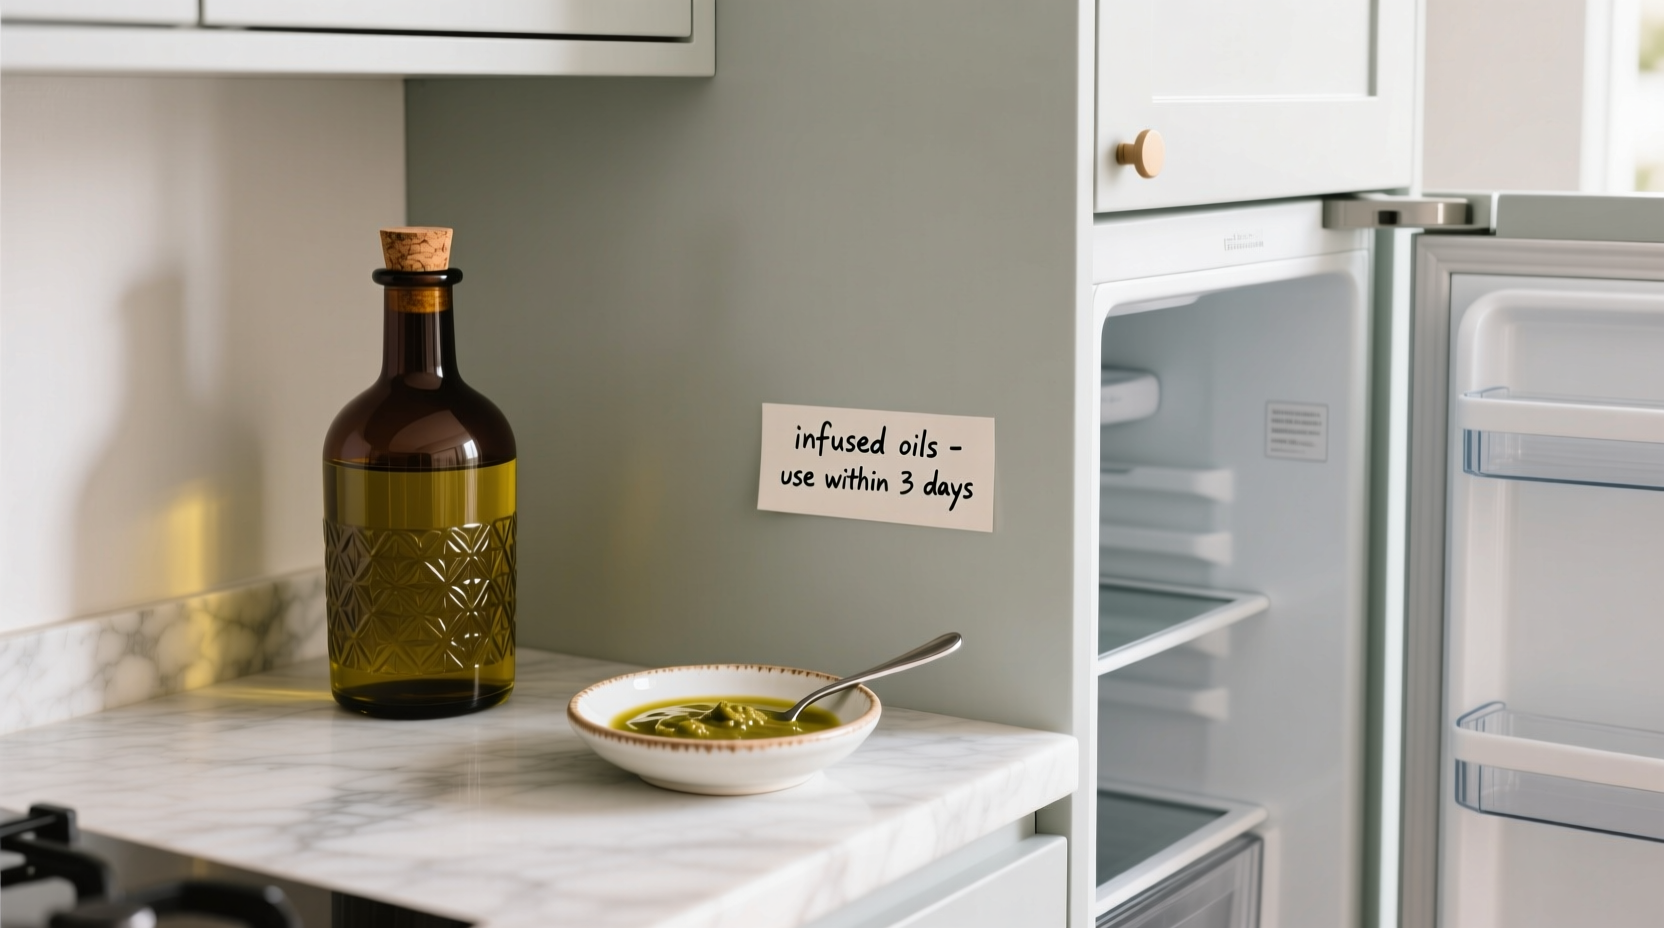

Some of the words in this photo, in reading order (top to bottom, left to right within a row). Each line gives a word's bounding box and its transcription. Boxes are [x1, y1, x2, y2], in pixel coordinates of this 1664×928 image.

[795, 420, 887, 457] infused
[899, 429, 938, 459] oils
[780, 470, 815, 487] use
[824, 465, 889, 492] within
[899, 470, 914, 495] 3
[923, 469, 974, 512] days
